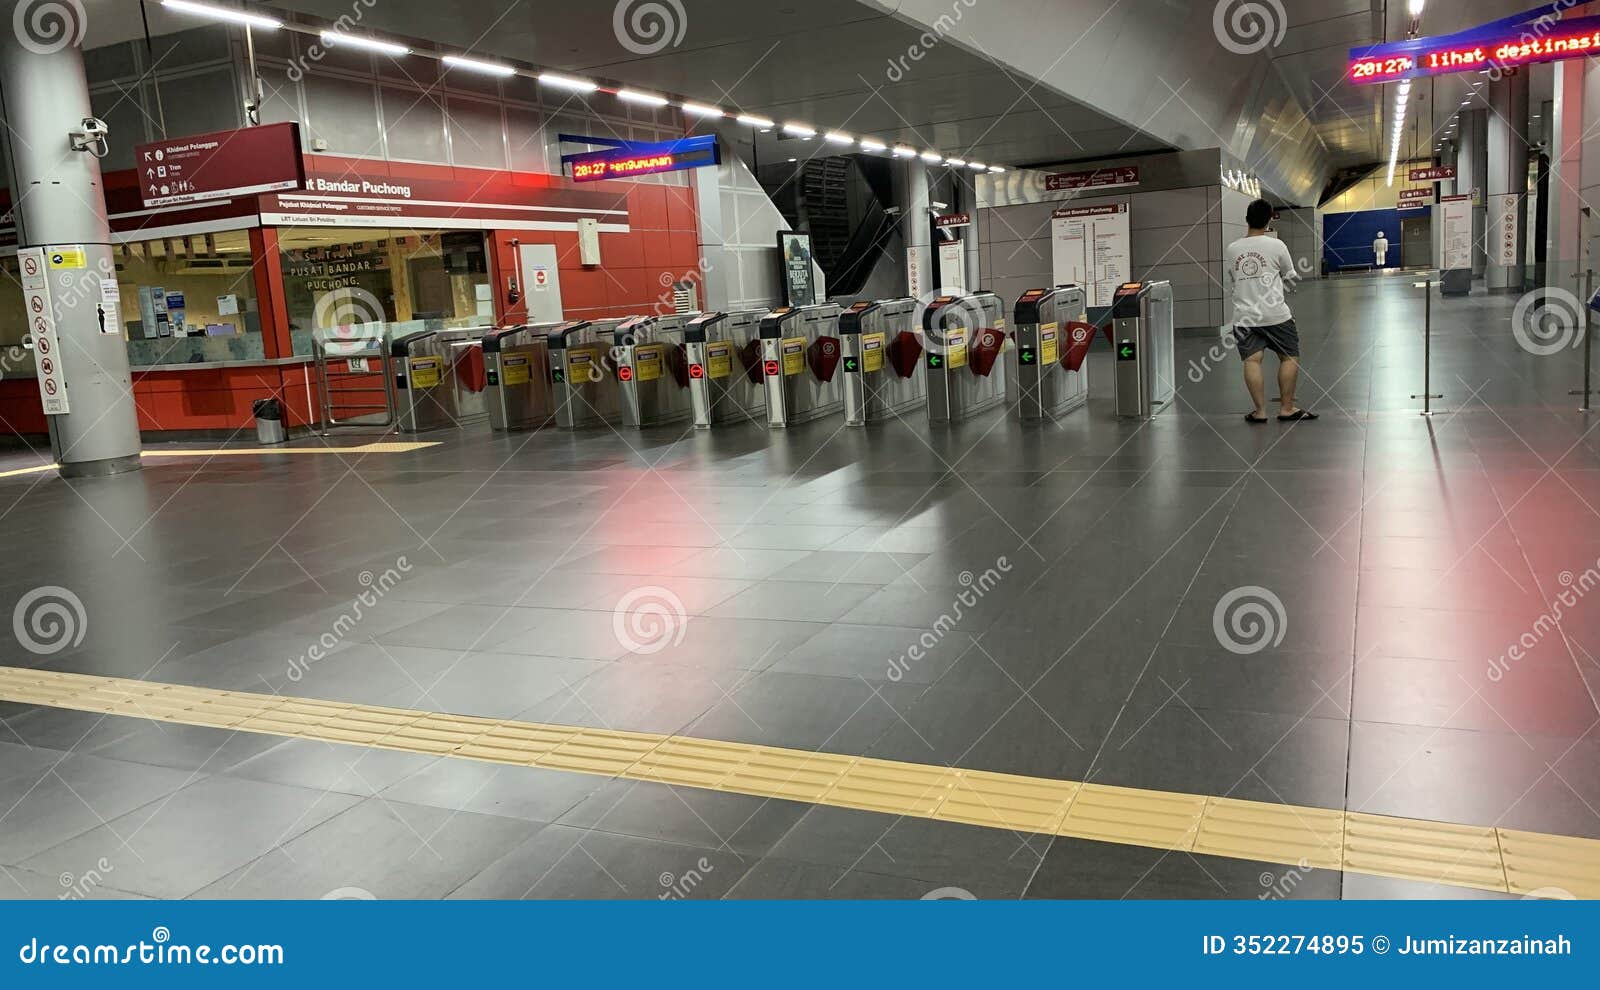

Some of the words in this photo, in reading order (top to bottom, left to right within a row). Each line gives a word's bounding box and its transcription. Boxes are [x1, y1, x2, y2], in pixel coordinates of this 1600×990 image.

[1429, 48, 1485, 67] lihat
[317, 178, 361, 193] Bandar
[362, 181, 411, 198] Puchong
[290, 265, 323, 277] PUSAT
[328, 261, 371, 274] BANDAR
